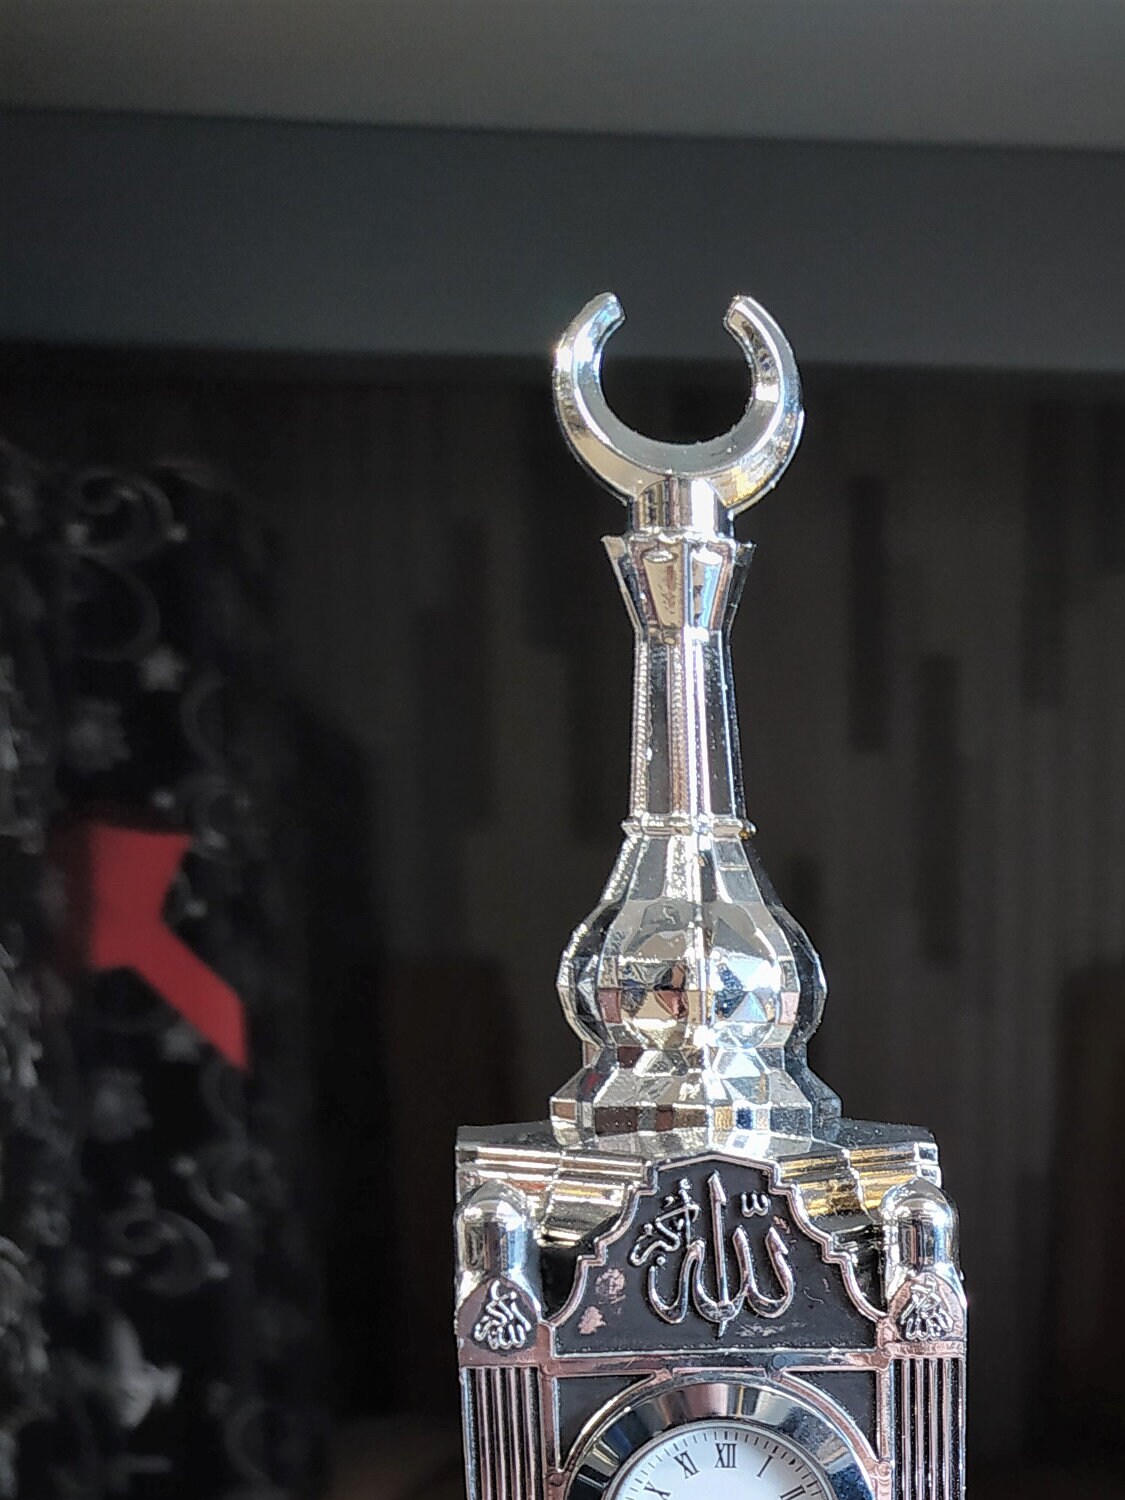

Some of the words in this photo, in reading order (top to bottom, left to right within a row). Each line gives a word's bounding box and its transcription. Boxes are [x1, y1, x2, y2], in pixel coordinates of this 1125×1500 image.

[673, 1451, 700, 1479] XI
[715, 1443, 737, 1468] XII
[756, 1455, 773, 1478] I
